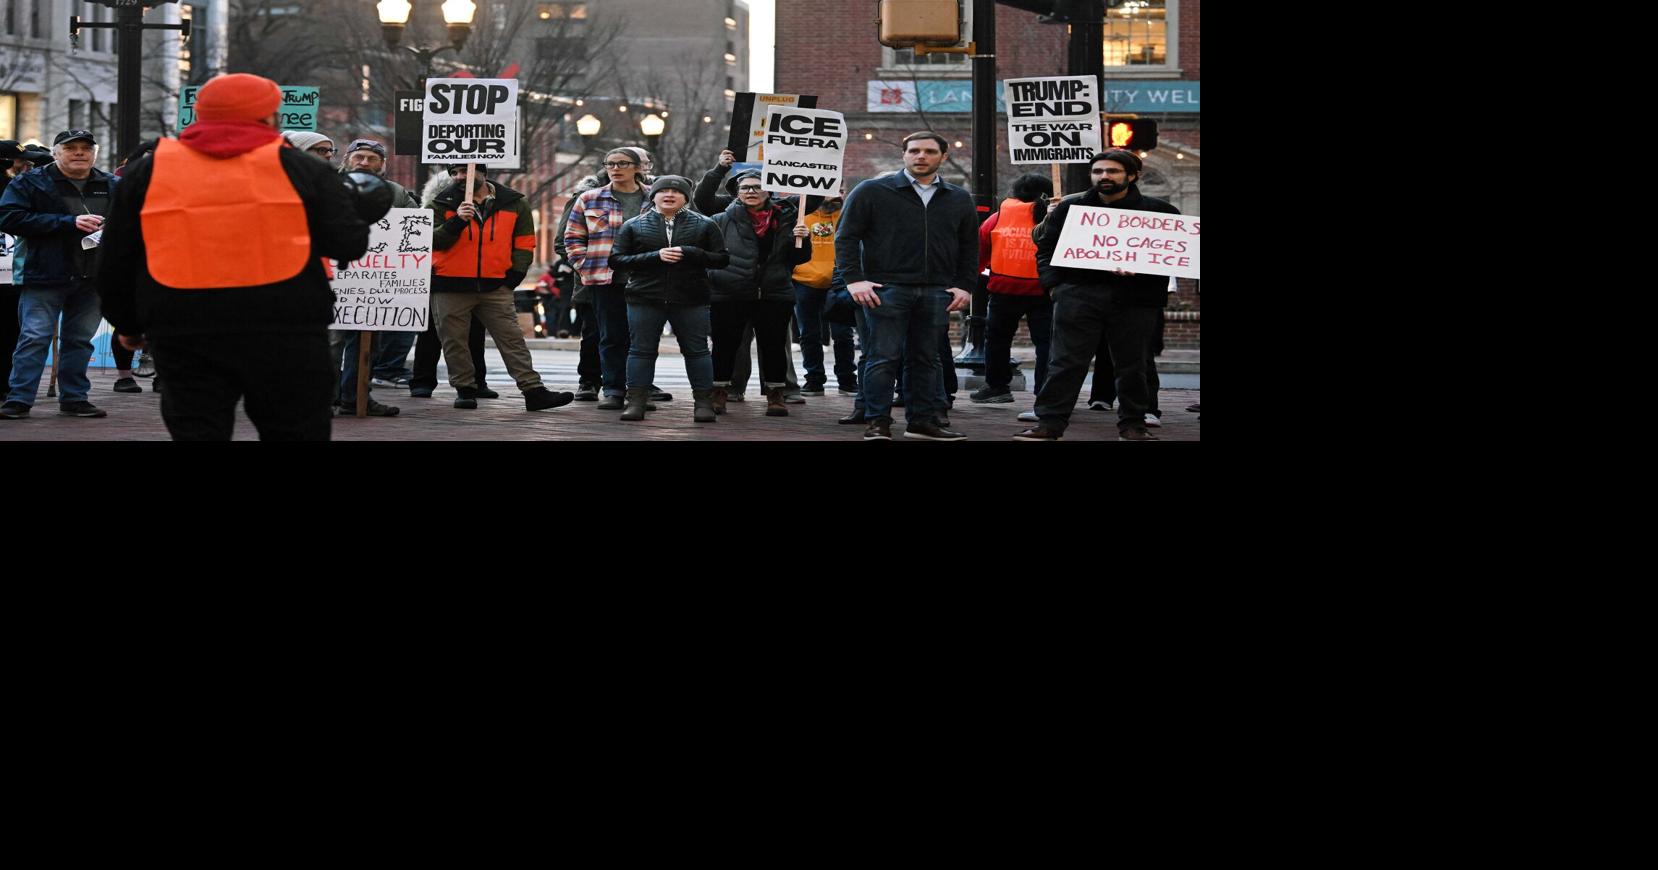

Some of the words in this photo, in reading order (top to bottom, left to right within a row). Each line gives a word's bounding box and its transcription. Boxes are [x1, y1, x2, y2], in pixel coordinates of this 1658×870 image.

[929, 90, 973, 104] LAN
[1104, 89, 1138, 103] ITY
[1009, 80, 1090, 101] TRUMP:
[400, 98, 424, 112] FIG
[429, 83, 509, 115] STOP
[1011, 102, 1092, 117] END
[280, 112, 312, 126] nee
[769, 113, 842, 138] ICE
[428, 124, 505, 139] DEPORTING
[1012, 124, 1047, 132] THE
[1048, 123, 1093, 131] WAR
[427, 138, 506, 154] OUR
[767, 134, 839, 150] FUERA
[1023, 131, 1082, 147] ON
[1014, 147, 1095, 161] IMMIGRANTS
[768, 159, 838, 171] LANCASTER
[766, 172, 837, 190] NOW
[1080, 212, 1110, 227] NO
[1117, 214, 1200, 235] BORDERS
[1092, 234, 1119, 247] NO
[1126, 236, 1188, 253] CAGES
[1063, 247, 1137, 262] ABOLISH
[1148, 252, 1191, 267] ICE
[337, 271, 397, 279] EPARATES
[379, 279, 426, 287] FAMILIES
[355, 296, 394, 305] NOW
[334, 305, 426, 327] XECUTION
